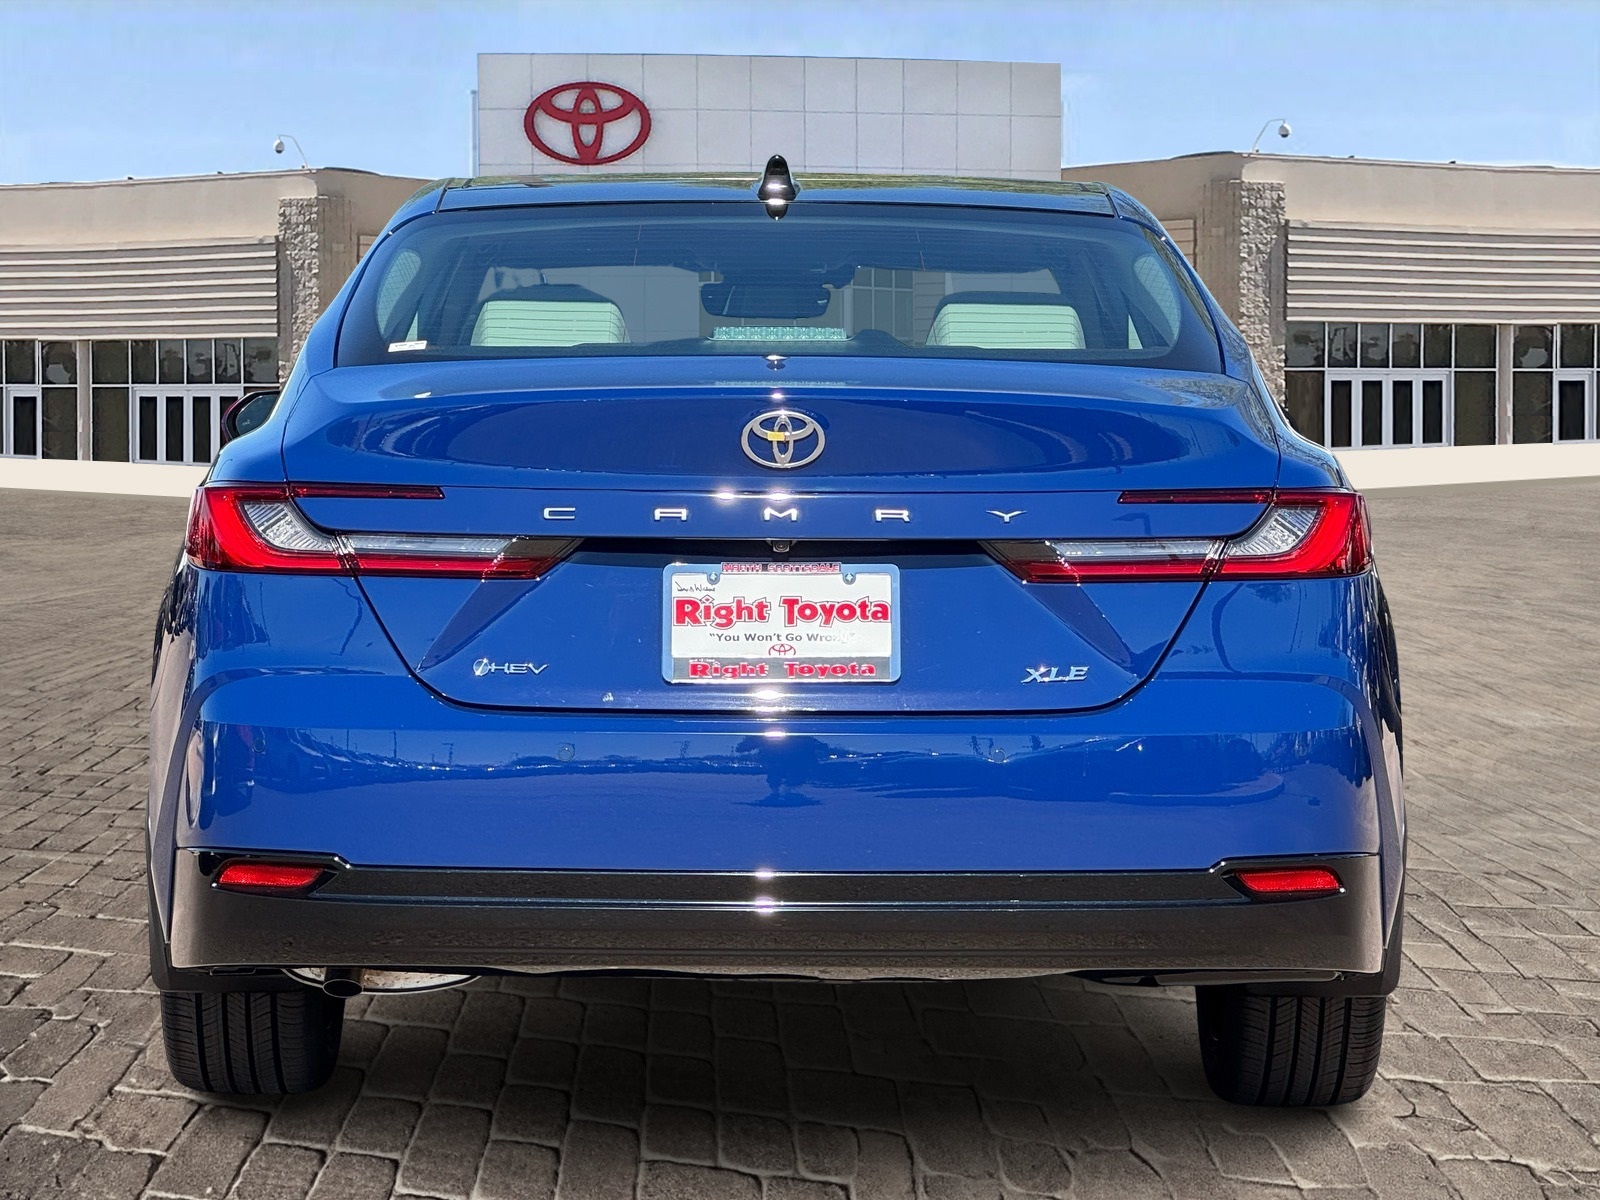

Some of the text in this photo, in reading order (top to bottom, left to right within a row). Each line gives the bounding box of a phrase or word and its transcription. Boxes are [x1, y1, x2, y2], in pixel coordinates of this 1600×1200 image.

[543, 507, 1027, 522] CAMRY
[673, 595, 892, 630] Right Toyota
[744, 633, 782, 642] Won't
[785, 633, 803, 642] Go
[490, 662, 549, 674] HEV
[689, 661, 876, 679] Right Toyota
[1021, 666, 1090, 683] XLE
